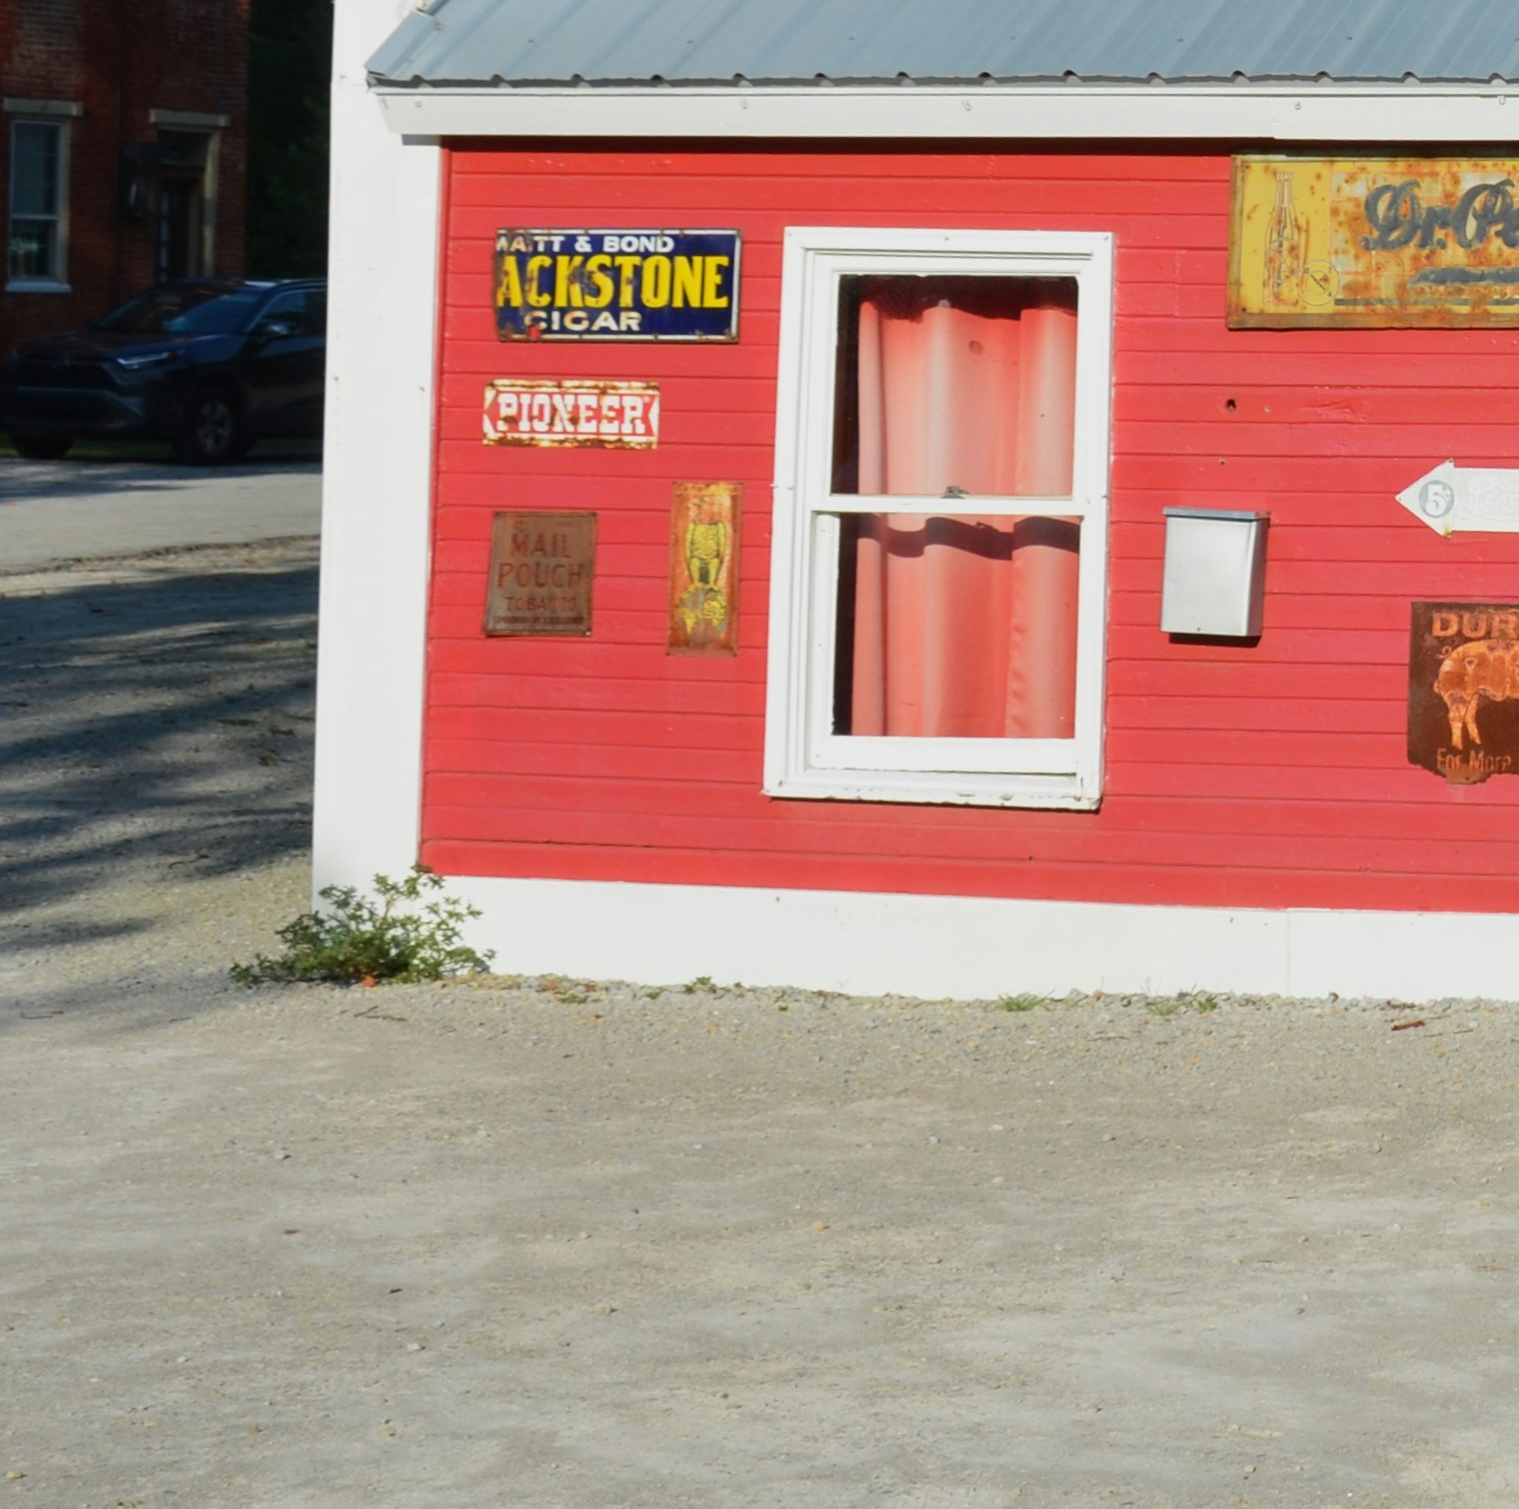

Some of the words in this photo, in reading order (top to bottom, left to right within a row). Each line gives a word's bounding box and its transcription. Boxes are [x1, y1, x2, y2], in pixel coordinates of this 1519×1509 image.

[574, 236, 592, 253] &
[603, 236, 675, 253] BOND
[524, 311, 642, 331] CIGAR
[497, 393, 646, 434] PIONEER
[511, 533, 572, 558] MAIL
[498, 561, 586, 588] POUCH
[1468, 749, 1512, 772] More
